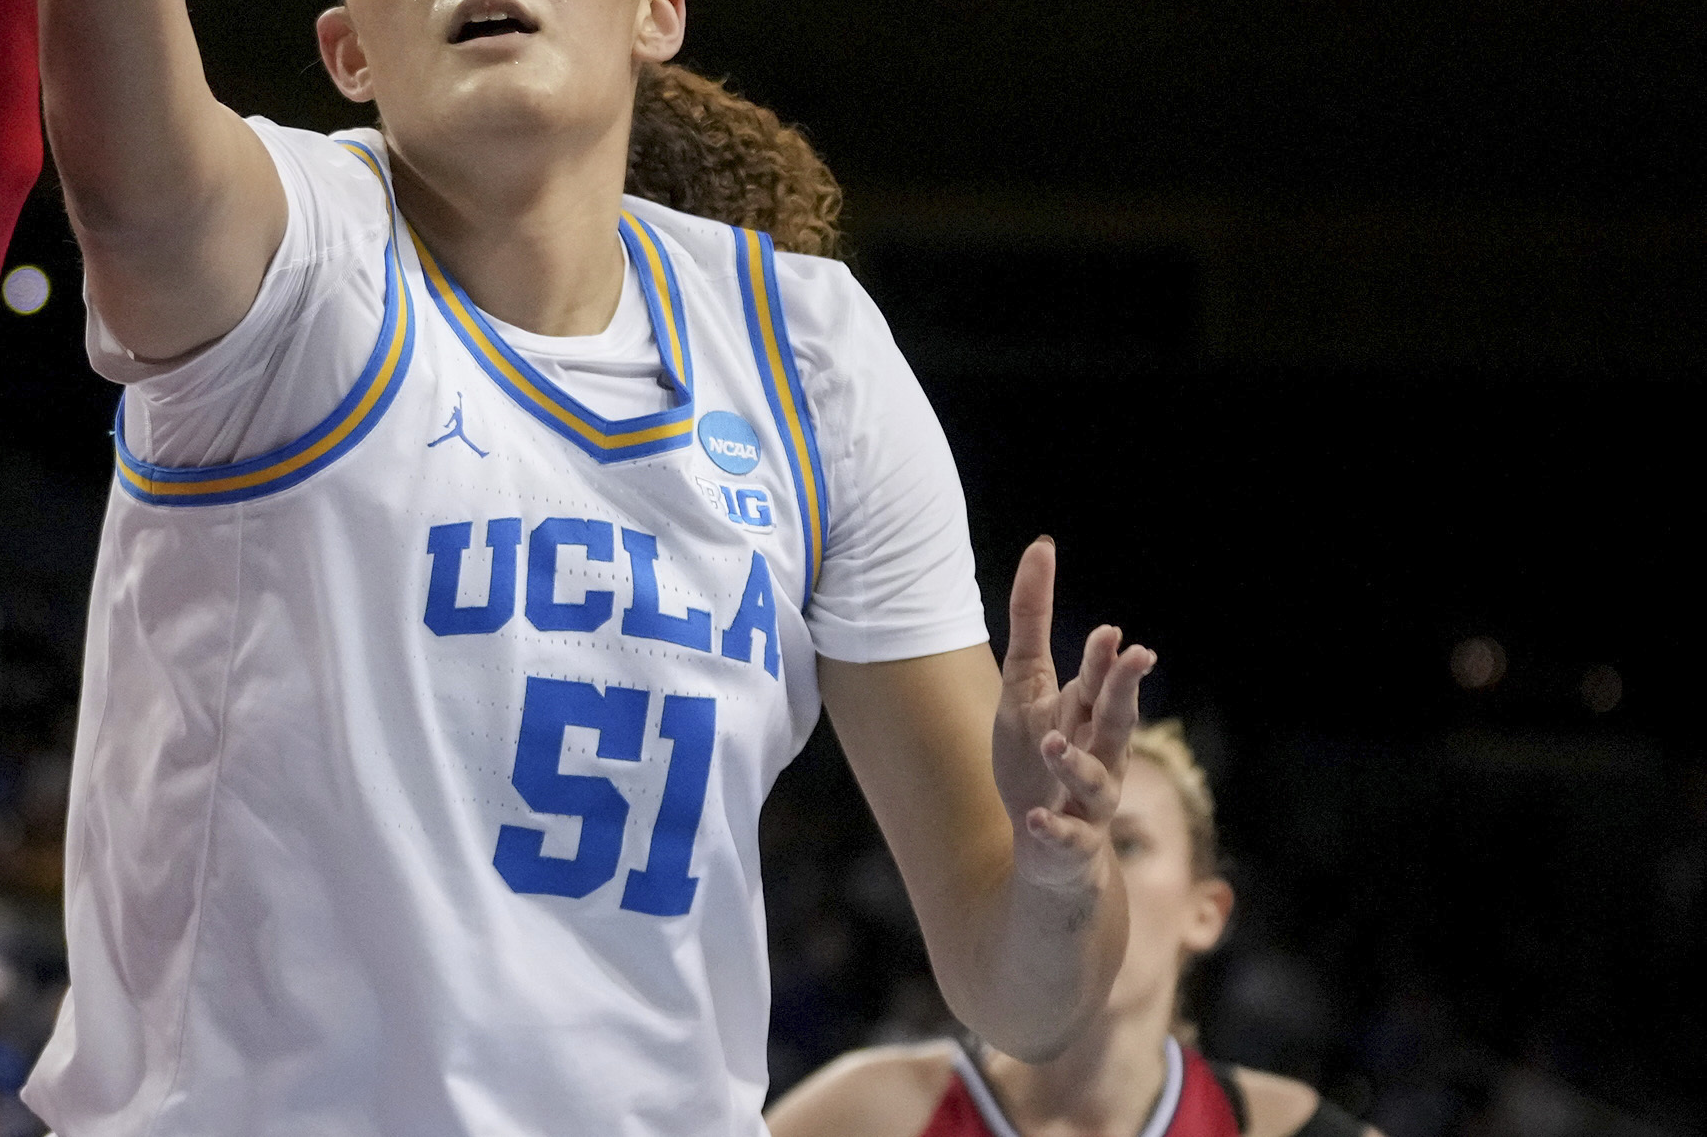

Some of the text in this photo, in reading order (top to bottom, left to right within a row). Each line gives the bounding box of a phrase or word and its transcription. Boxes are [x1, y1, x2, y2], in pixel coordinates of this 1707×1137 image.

[708, 435, 759, 462] NCAA
[423, 517, 781, 681] UCLA
[493, 675, 717, 917] 51
